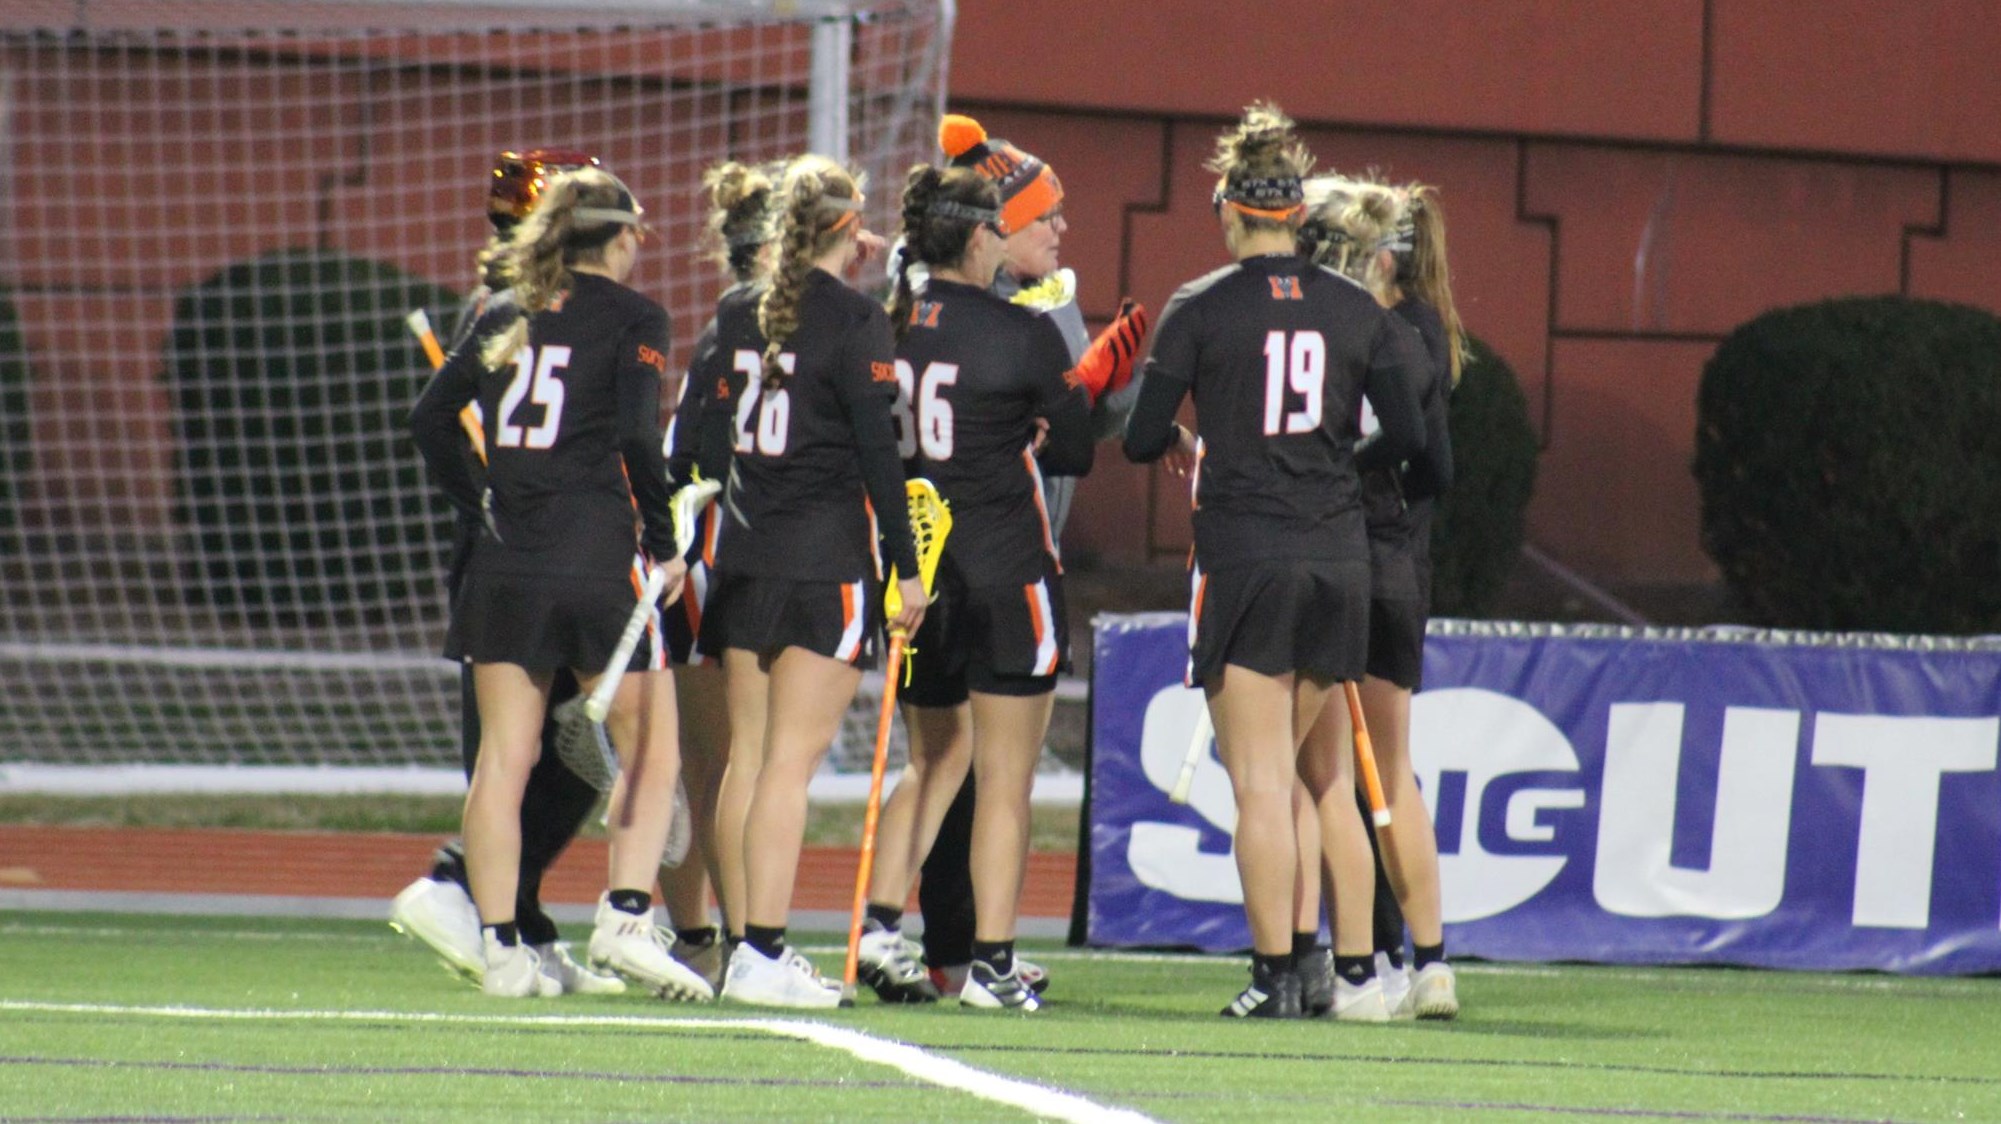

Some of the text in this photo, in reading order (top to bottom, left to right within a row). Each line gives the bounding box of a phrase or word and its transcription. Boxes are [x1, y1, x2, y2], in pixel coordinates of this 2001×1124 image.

[496, 345, 571, 448] 25
[733, 349, 796, 456] 26
[1264, 330, 1326, 436] 19
